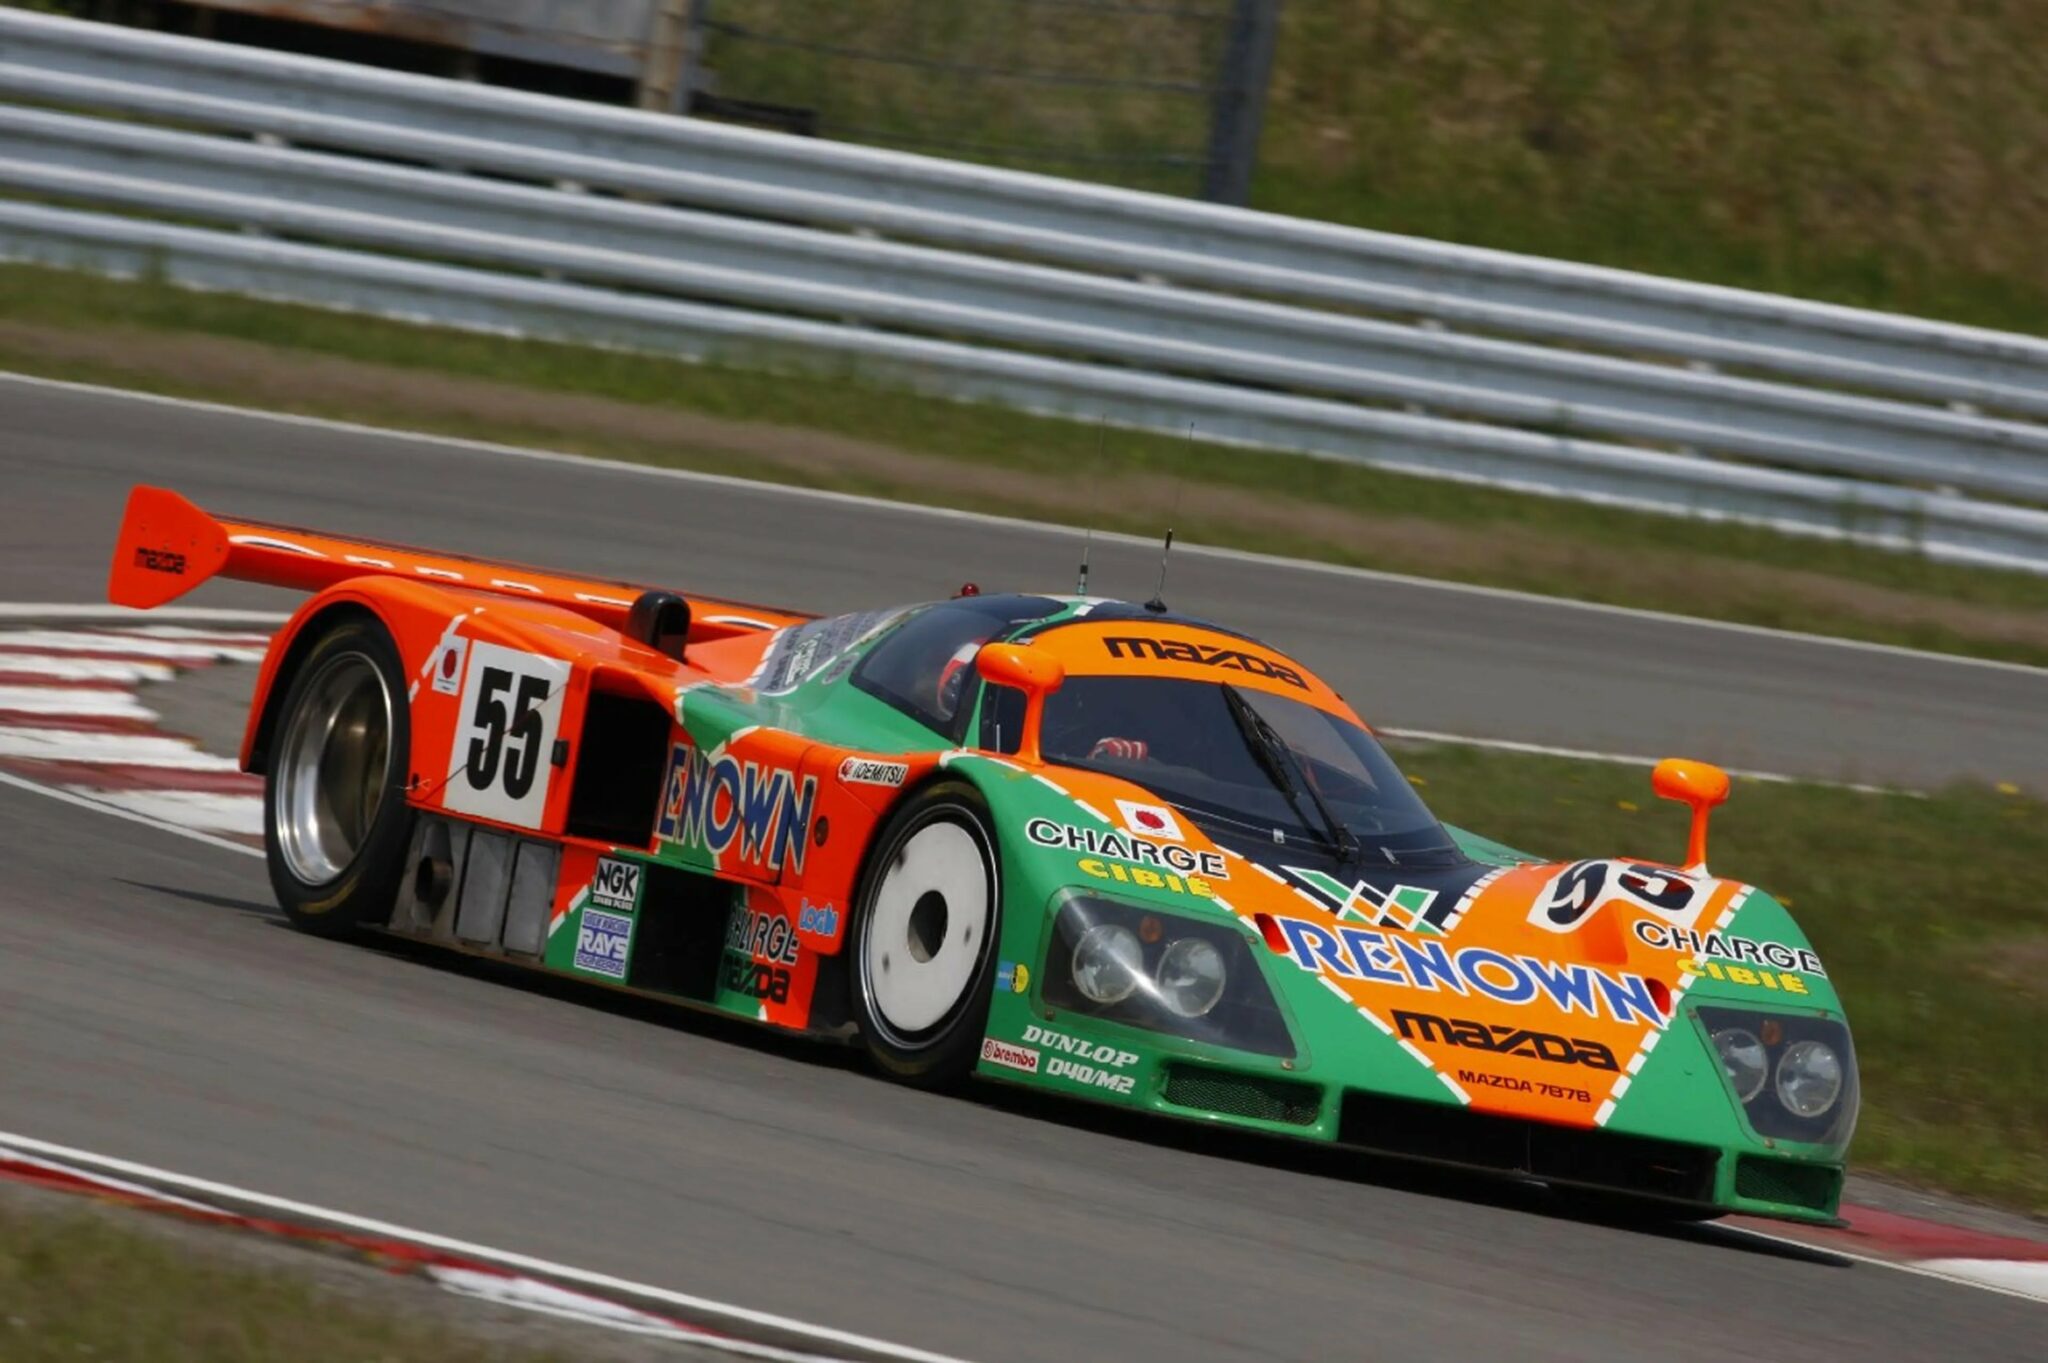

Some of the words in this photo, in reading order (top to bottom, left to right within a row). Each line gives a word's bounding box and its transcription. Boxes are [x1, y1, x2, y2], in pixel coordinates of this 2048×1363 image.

[1102, 637, 1311, 691] mazda
[467, 667, 550, 800] 55
[853, 762, 907, 785] IDEMITSU
[1025, 816, 1231, 881] CHARGE
[596, 861, 638, 898] NGK
[579, 929, 628, 960] RAYS
[1633, 919, 1828, 978] CHARGE
[1273, 915, 1669, 1028] RENOWN
[993, 1044, 1036, 1068] brembo
[1022, 1025, 1139, 1067] DUNLOP
[1390, 1009, 1621, 1073] mazda
[1046, 1058, 1135, 1094] D40/M2
[1458, 1070, 1533, 1093] MAZDA
[1535, 1082, 1592, 1103] 787B
